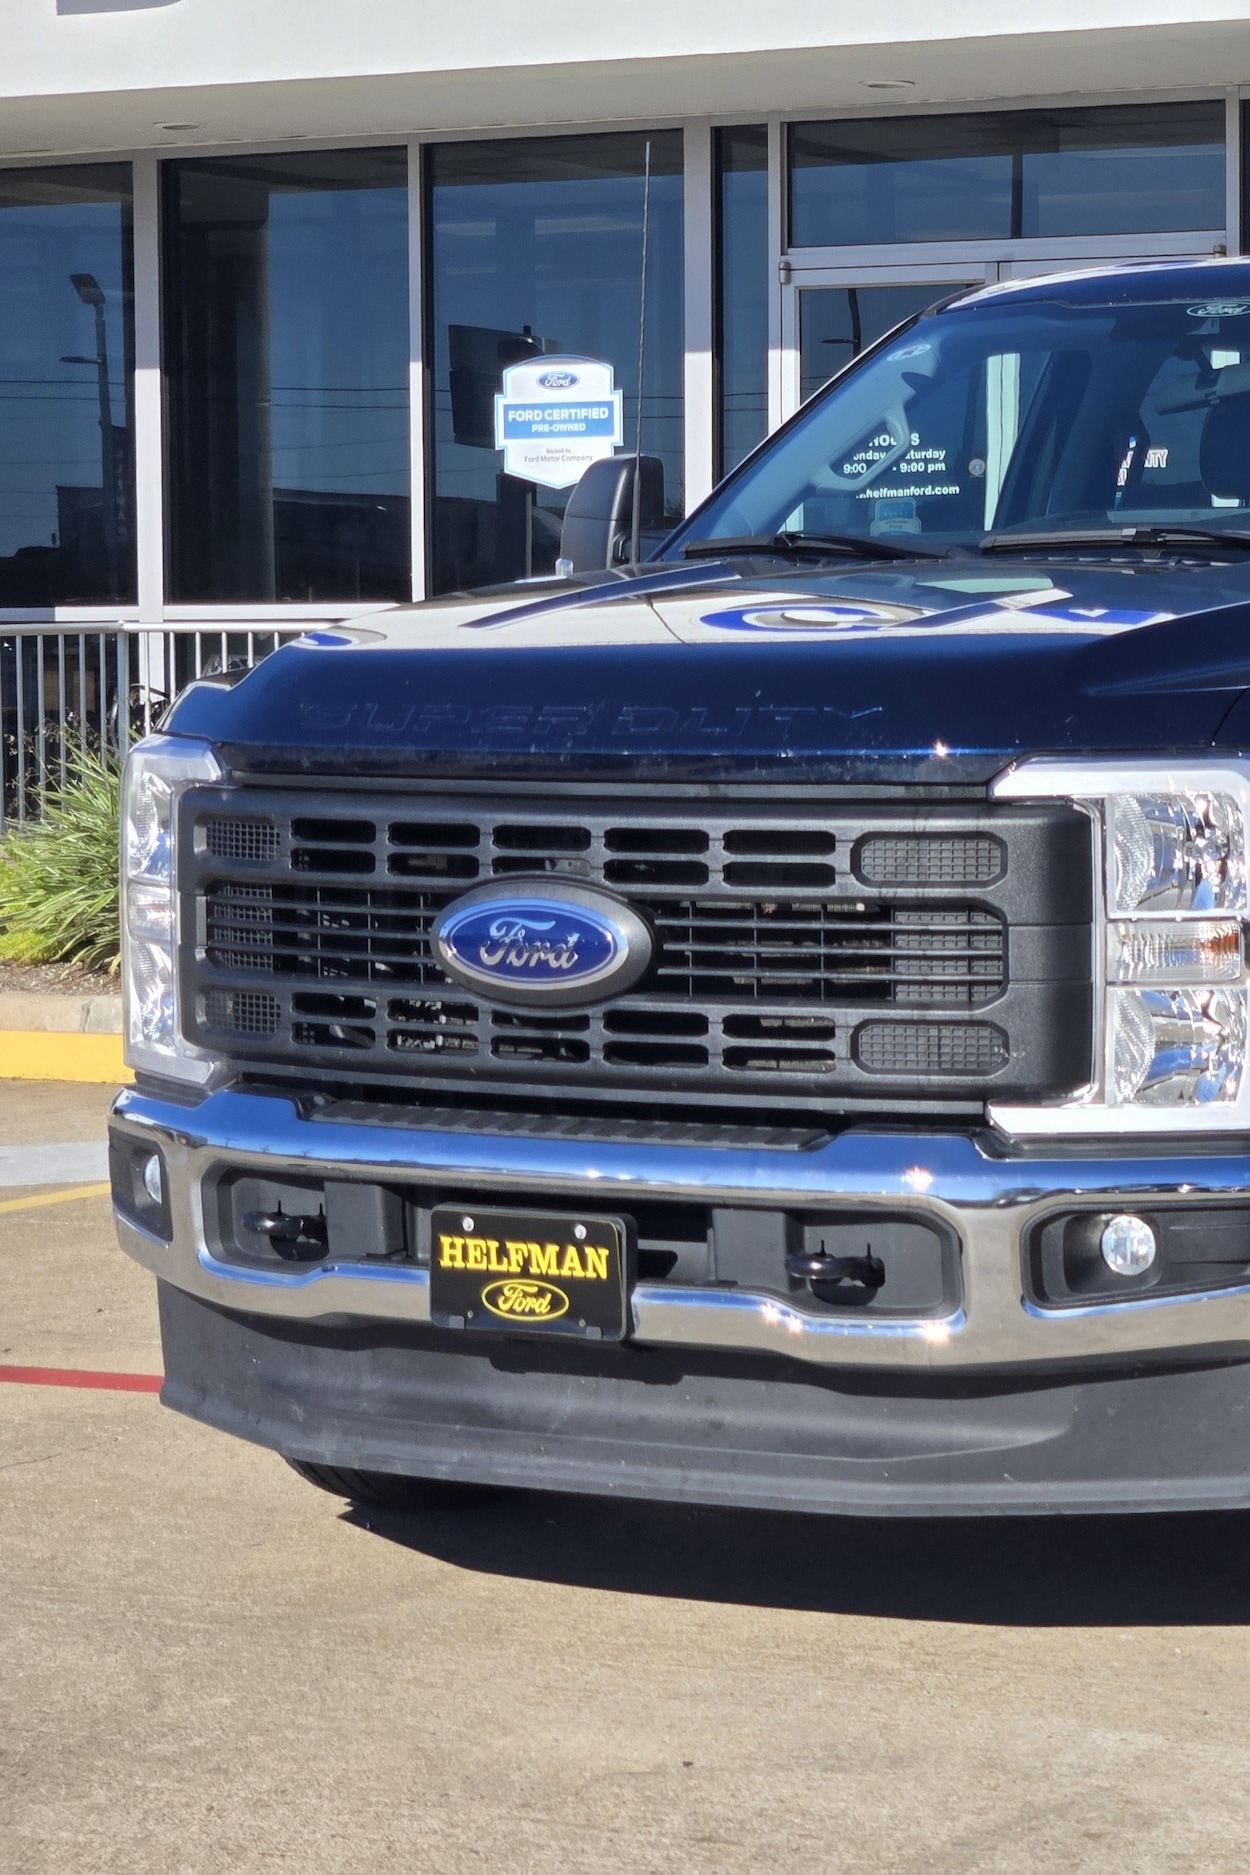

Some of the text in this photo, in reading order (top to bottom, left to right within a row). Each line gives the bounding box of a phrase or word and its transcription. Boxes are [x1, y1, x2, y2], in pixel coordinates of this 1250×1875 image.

[544, 372, 571, 387] Ford
[508, 407, 609, 422] FORD CERTIFIED
[531, 423, 586, 433] PRE-OWNED
[905, 449, 946, 460] turday
[843, 463, 867, 474] 9:00
[900, 462, 925, 473] 9:00
[927, 462, 946, 474] pm
[612, 704, 883, 736] DUTY
[480, 916, 580, 970] Ford
[438, 1234, 610, 1280] HELFMAN
[498, 1283, 552, 1314] Ford
